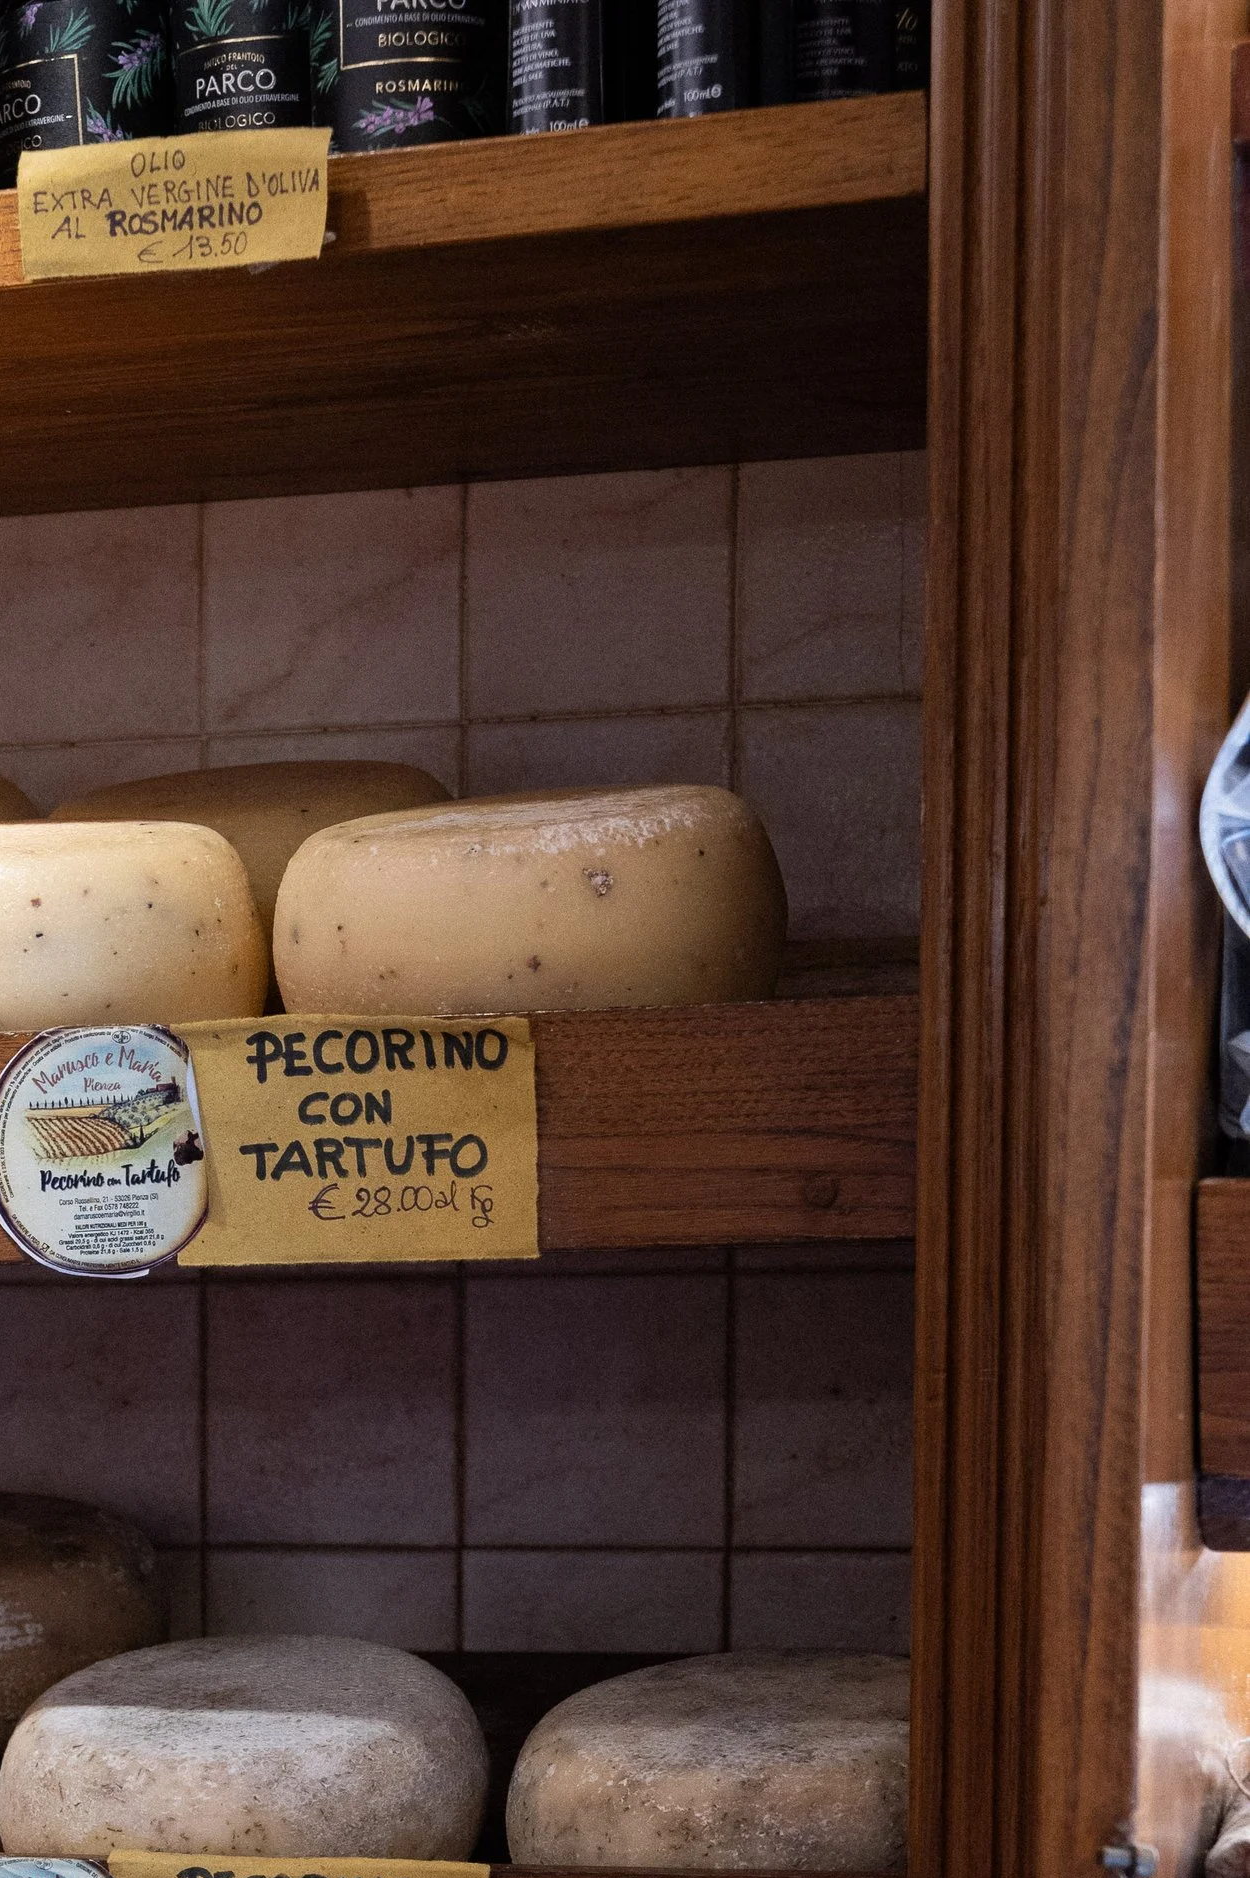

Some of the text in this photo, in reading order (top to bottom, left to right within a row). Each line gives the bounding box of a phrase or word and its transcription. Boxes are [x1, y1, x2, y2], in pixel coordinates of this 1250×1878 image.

[354, 14, 397, 28] CONDIMENTO
[404, 12, 421, 23] BASE
[422, 11, 430, 22] DI
[430, 11, 446, 22] OLIO
[378, 30, 465, 48] BIOLOGICO
[203, 52, 265, 71] ANTICO FRANTOIO
[226, 63, 238, 71] DEL
[196, 68, 276, 99] PARCO
[375, 79, 459, 94] ROSMARIN
[216, 98, 231, 108] BASE
[239, 95, 254, 104] OLIO
[255, 93, 301, 104] EXTRAVERGINE
[24, 113, 65, 128] EXTRAVERGINE
[198, 111, 276, 131] BIOLOGICO
[130, 149, 186, 176] OLIO
[32, 168, 320, 215] EXTRA VERGINE D'OLIVA
[51, 201, 264, 240] AL ROSMARINO
[136, 230, 248, 264] € 13.50
[245, 1027, 509, 1084] PECORINO
[32, 1045, 163, 1094] Marusco e Maria
[83, 1076, 121, 1093] Pienza
[297, 1088, 393, 1126] CON
[239, 1131, 489, 1182] TARTUFO
[39, 1158, 181, 1192] Pecorino con Tartufo
[58, 1193, 149, 1206] Corso Pienza
[119, 1202, 139, 1210] 748222
[308, 1183, 346, 1221] €
[351, 1185, 435, 1219] 28.00
[469, 1184, 495, 1229] Kg
